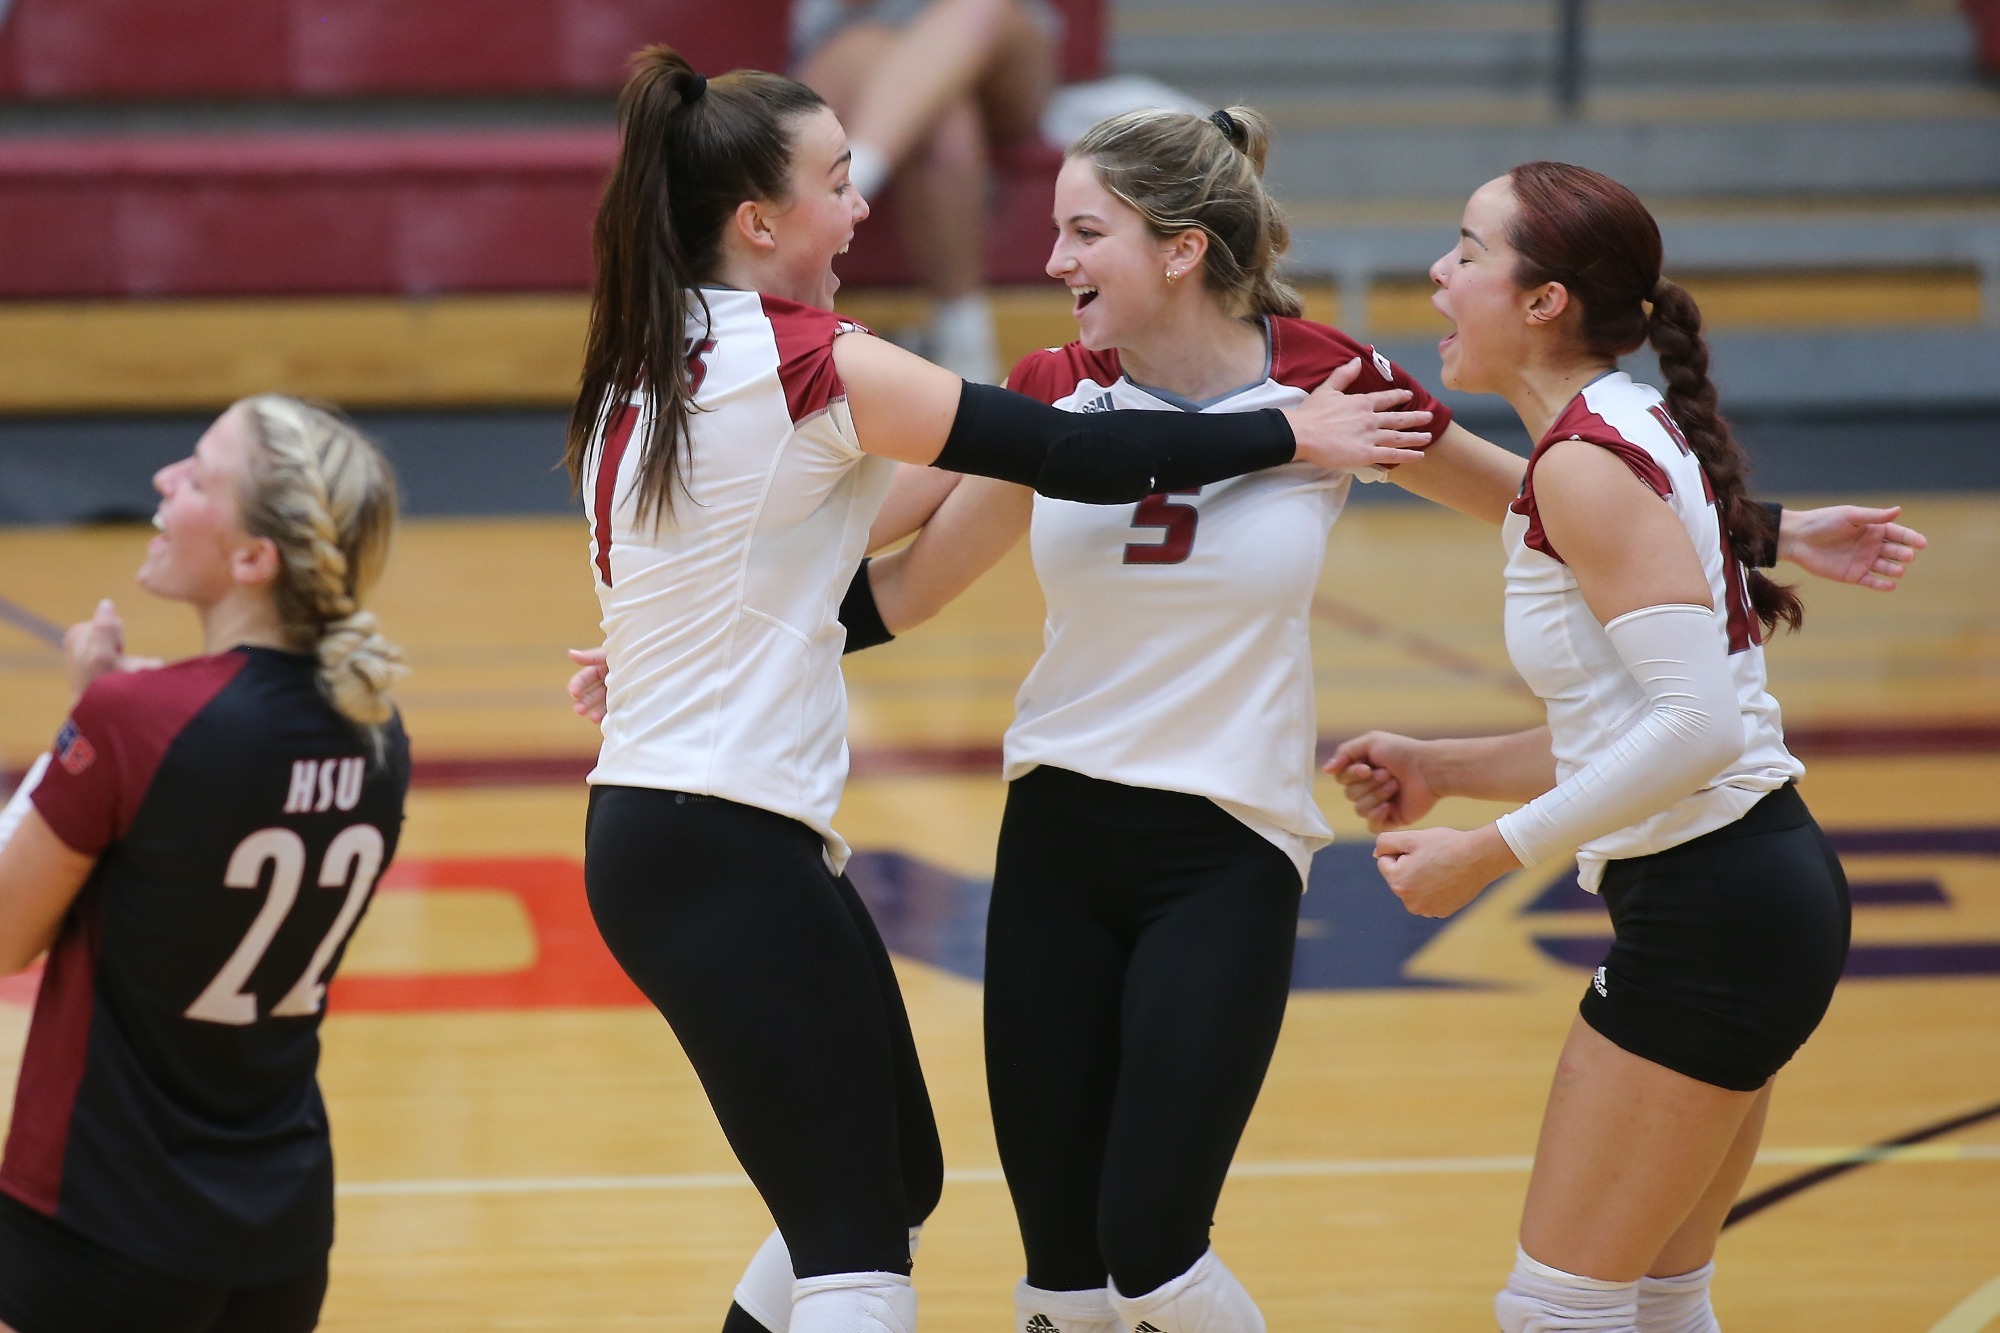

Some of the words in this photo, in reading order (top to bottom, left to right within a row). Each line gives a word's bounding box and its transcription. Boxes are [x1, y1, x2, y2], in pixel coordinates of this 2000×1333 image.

[1123, 486, 1203, 565] 5
[284, 756, 366, 814] HSU
[183, 822, 385, 1026] 22
